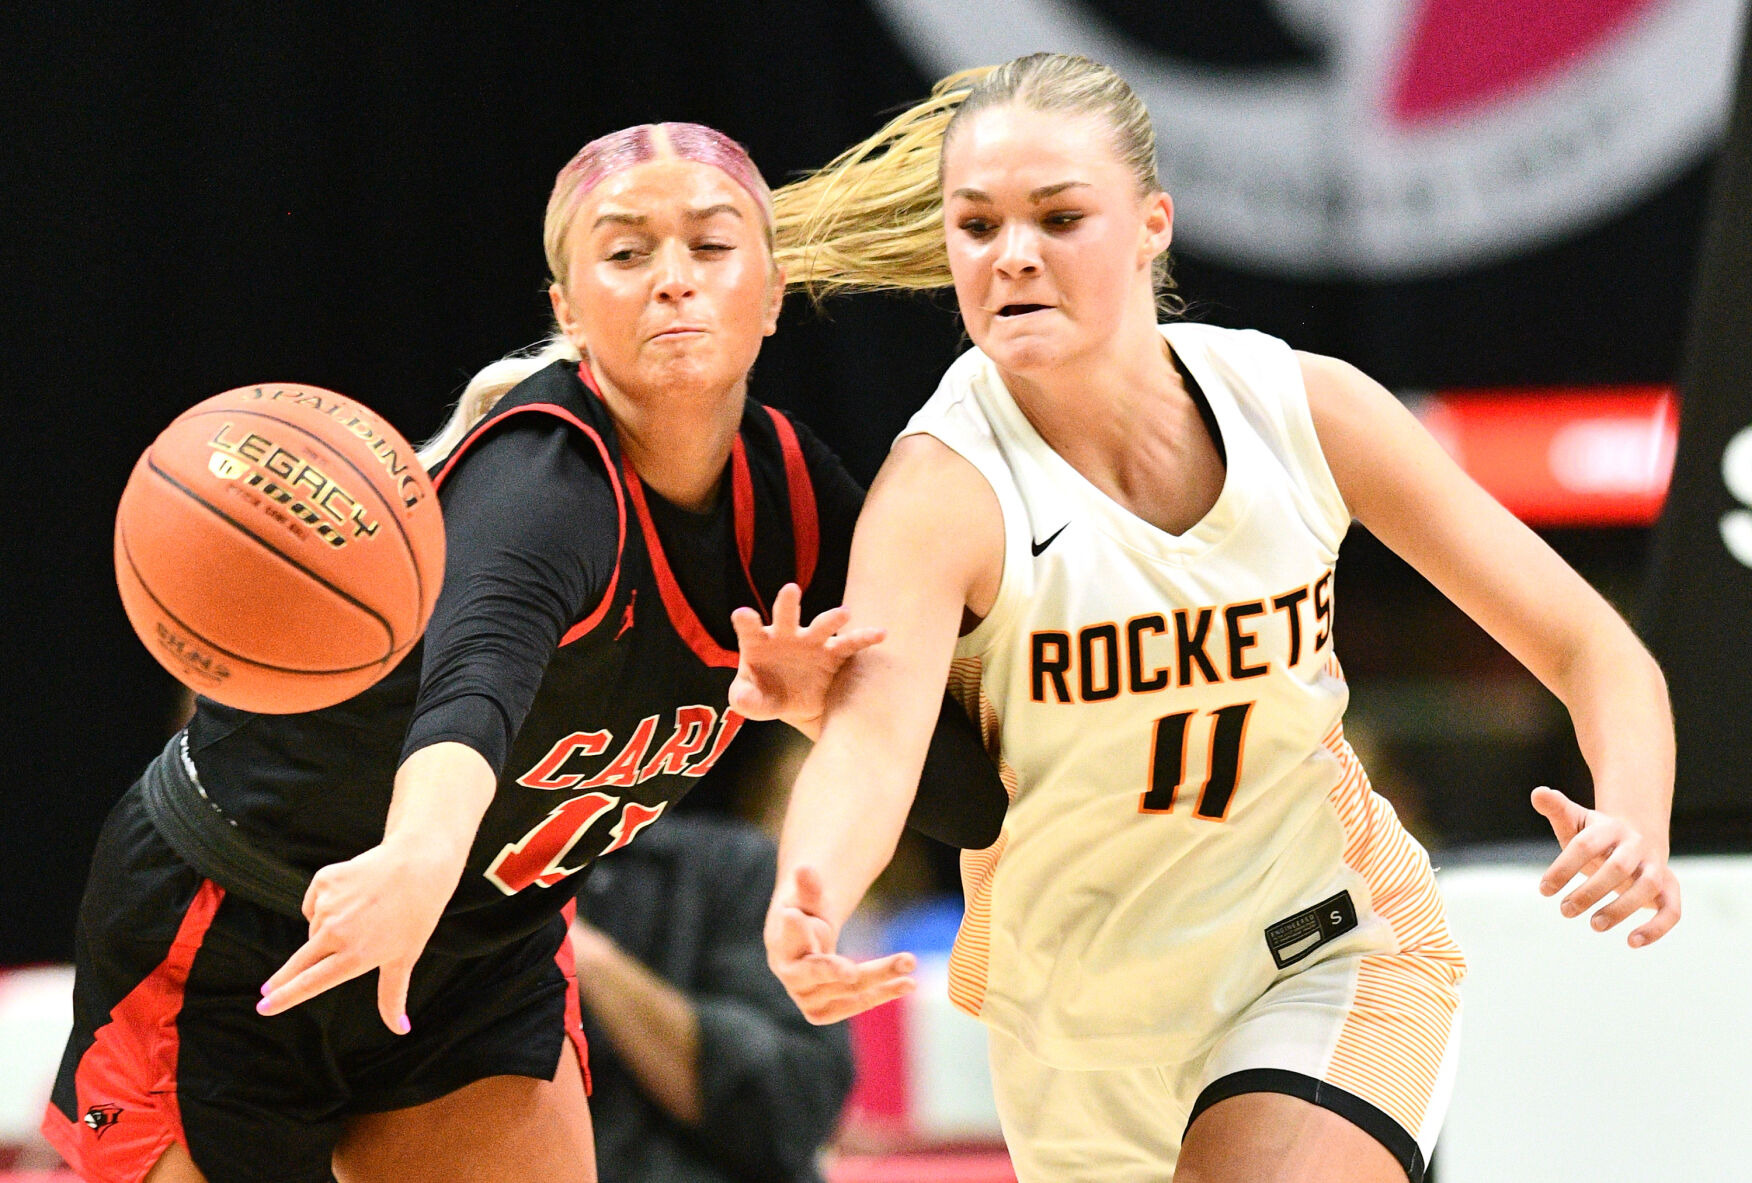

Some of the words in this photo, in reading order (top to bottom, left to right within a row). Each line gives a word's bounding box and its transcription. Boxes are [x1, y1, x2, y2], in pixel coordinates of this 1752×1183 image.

[207, 421, 381, 541] LEGACY
[1029, 568, 1333, 705] ROCKETS
[1138, 700, 1257, 822] 11
[1330, 910, 1343, 925] S
